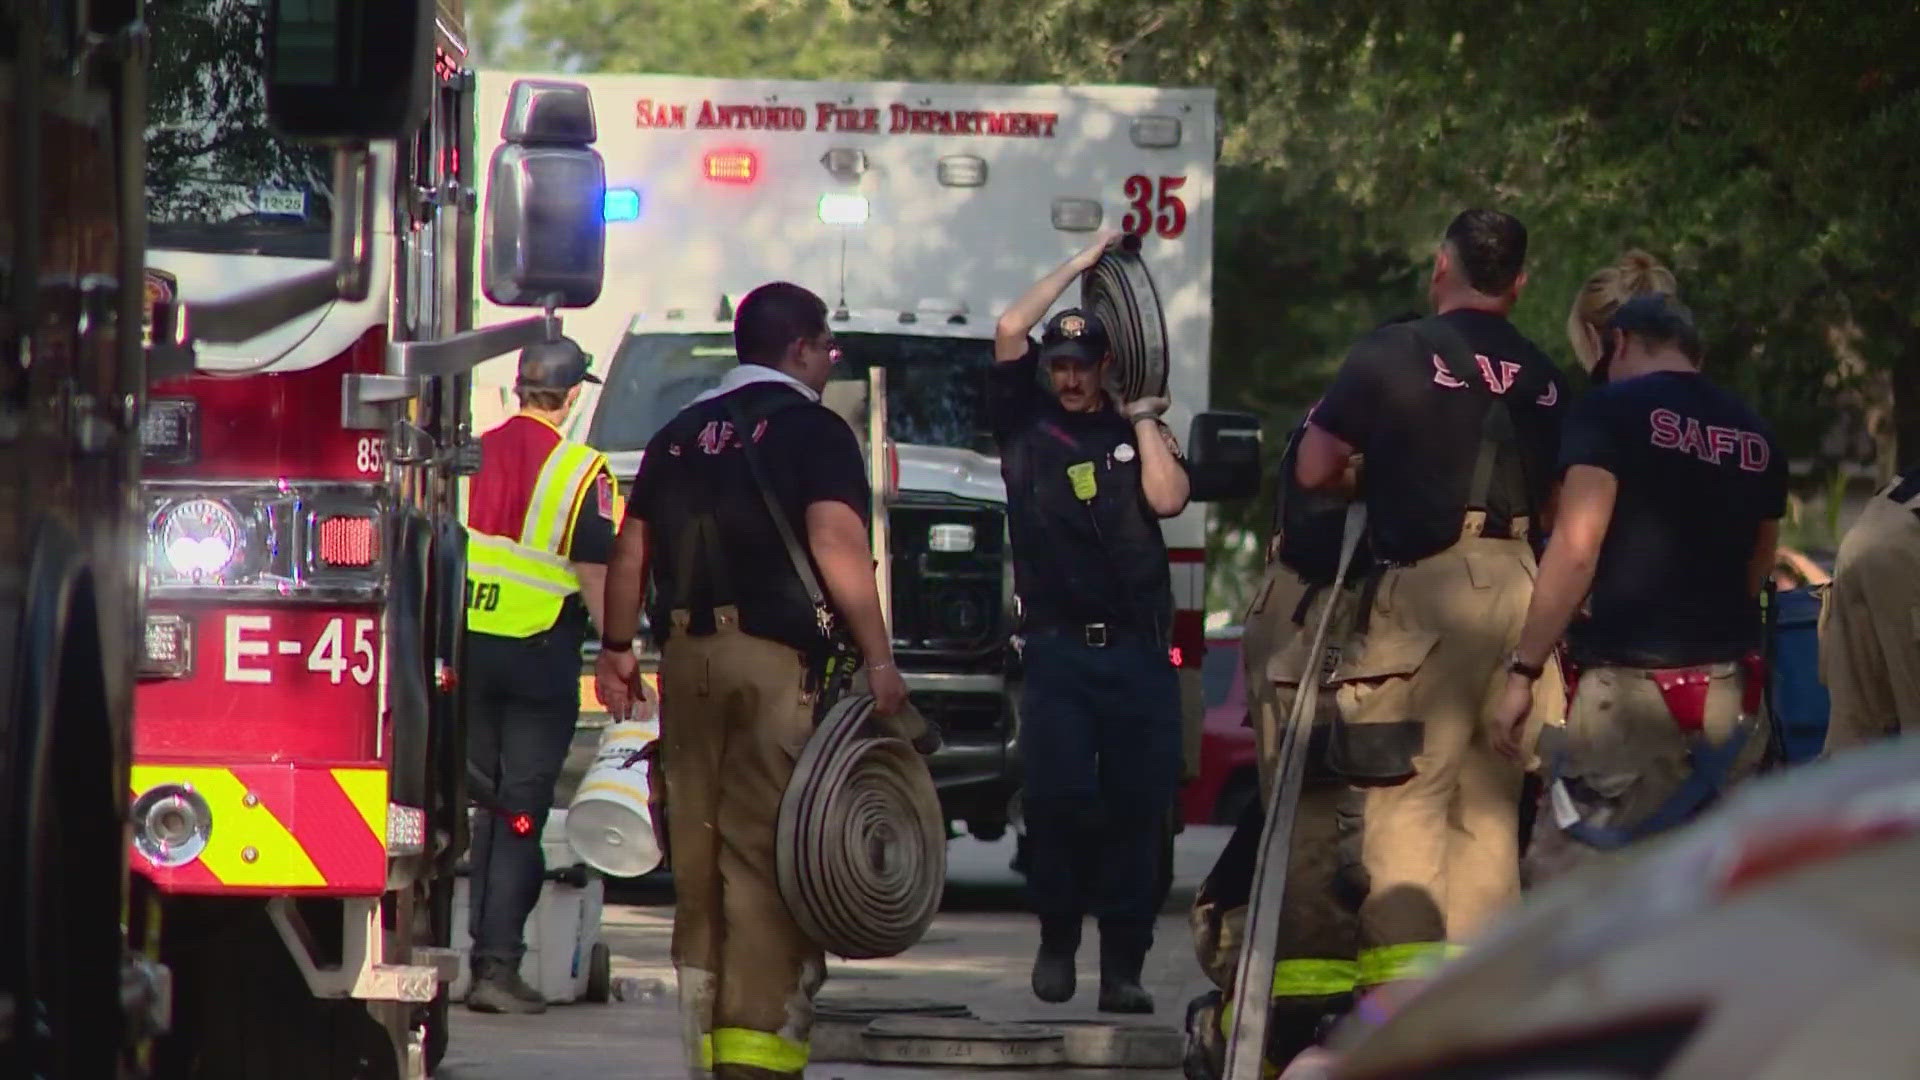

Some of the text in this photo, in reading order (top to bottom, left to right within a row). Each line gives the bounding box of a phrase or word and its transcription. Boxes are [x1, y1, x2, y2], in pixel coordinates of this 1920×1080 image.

[1122, 174, 1187, 240] 35
[1650, 407, 1770, 473] SAFD
[224, 614, 375, 686] E-45
